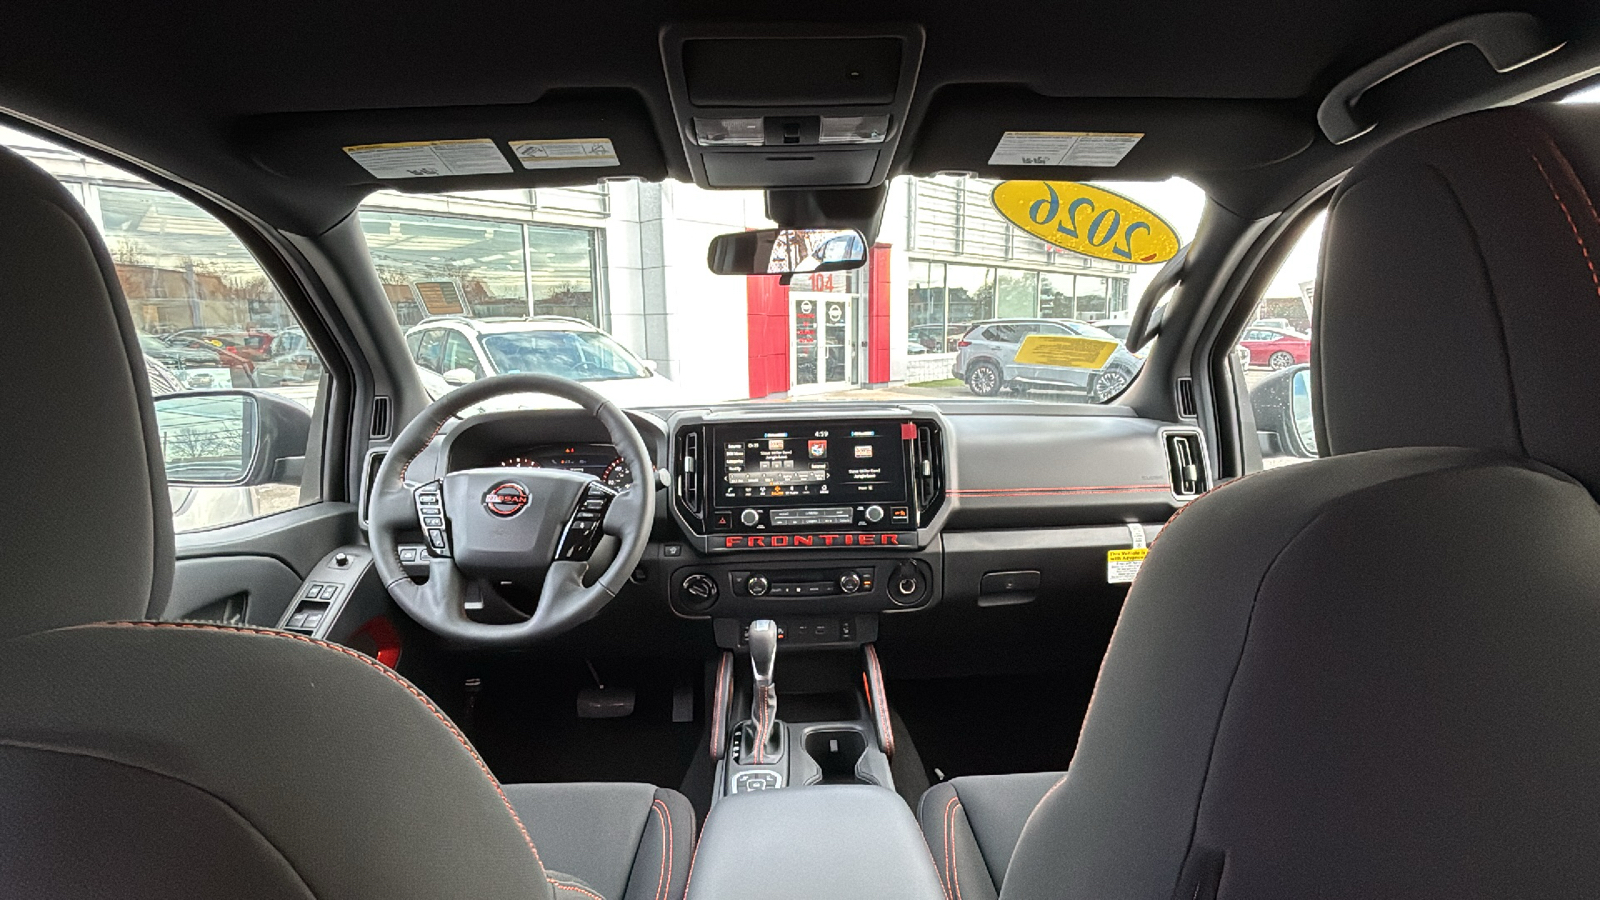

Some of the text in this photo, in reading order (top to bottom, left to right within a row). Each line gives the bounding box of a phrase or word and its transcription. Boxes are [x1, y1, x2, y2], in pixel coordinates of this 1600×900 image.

[808, 273, 834, 292] 104
[486, 494, 527, 503] NISSAN
[725, 534, 899, 547] FRONTIER
